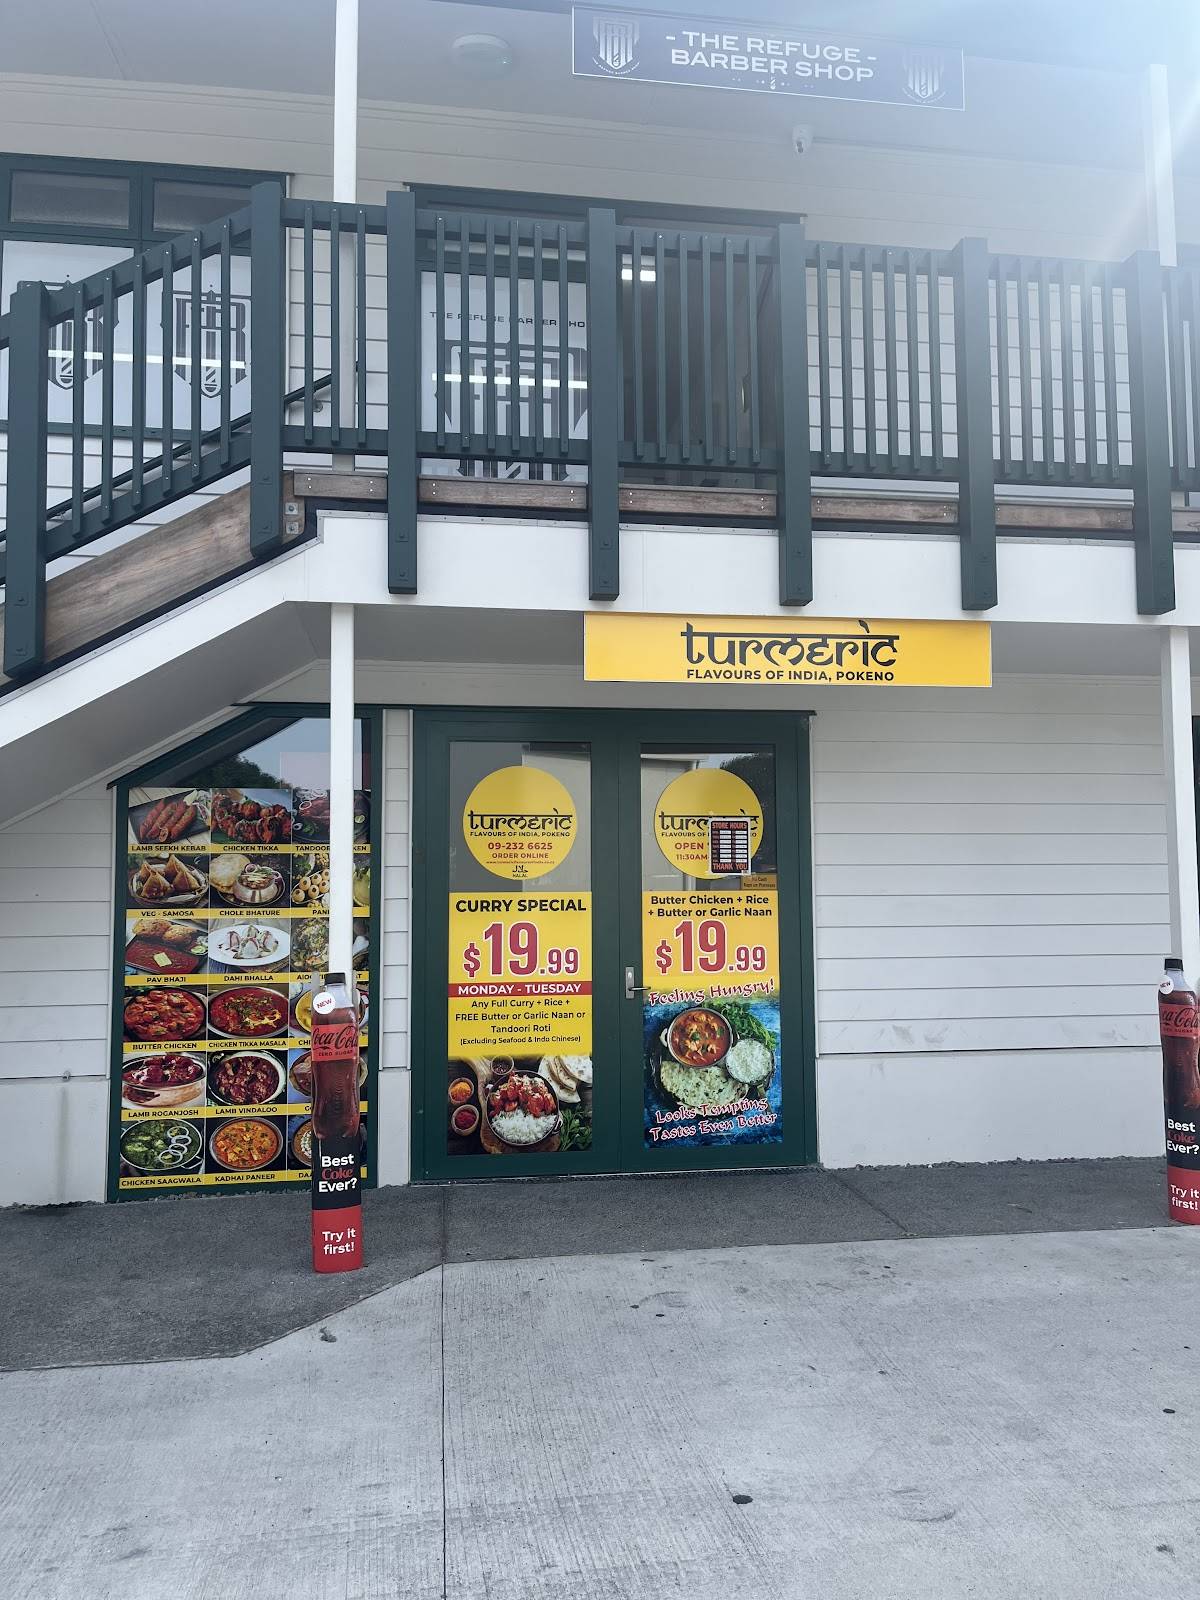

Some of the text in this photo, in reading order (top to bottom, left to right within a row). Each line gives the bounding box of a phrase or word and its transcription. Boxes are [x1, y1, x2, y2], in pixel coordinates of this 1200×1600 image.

[683, 30, 740, 51] THE
[747, 37, 862, 63] REFUGE
[671, 48, 788, 75] BARBER
[795, 61, 874, 83] SHOP
[429, 311, 453, 319] TE
[686, 669, 895, 683] FLAVOURS OF INDIA, POKENO
[487, 842, 553, 850] 09-232 6625
[674, 842, 704, 850] OPEN
[455, 898, 587, 912] CURRY SPECIAL
[651, 895, 686, 904] Butter
[689, 895, 734, 904] Chicken
[745, 894, 769, 904] Rice
[657, 908, 693, 917] Butter
[695, 909, 707, 917] or
[709, 907, 742, 917] Garlic
[744, 908, 772, 916] Naan
[463, 920, 580, 978] $19.99
[656, 919, 766, 975] $19.99
[458, 984, 515, 995] MONDAY
[525, 983, 582, 994] TUESDAY
[648, 977, 774, 1006] Feeling Hungry!
[317, 998, 332, 1009] NEW
[471, 1000, 489, 1009] Any
[491, 999, 507, 1007] Full
[510, 999, 534, 1008] Curry
[544, 998, 563, 1006] Rice
[455, 1013, 479, 1021] FREE
[481, 1013, 509, 1021] Butter
[523, 1011, 549, 1020] Garlic
[551, 1011, 573, 1019] Naan
[491, 1023, 551, 1033] Tandoori Roti
[151, 1109, 199, 1117] ROGANJOSH
[238, 1106, 278, 1114] VINDALOO
[655, 1097, 769, 1124] Looks Tempting
[650, 1113, 778, 1142] Tastes Even Better
[1167, 1119, 1196, 1133] Best
[1168, 1130, 1196, 1143] Coke
[1167, 1140, 1200, 1155] Ever?
[321, 1153, 355, 1167] Best
[322, 1167, 354, 1180] Coke
[121, 1177, 202, 1187] CHICKEN SAAGWALA
[318, 1178, 358, 1193] Ever?
[1170, 1184, 1200, 1199] Try it
[1171, 1196, 1198, 1210] first!
[322, 1228, 356, 1243] Try it
[323, 1242, 355, 1255] first!
